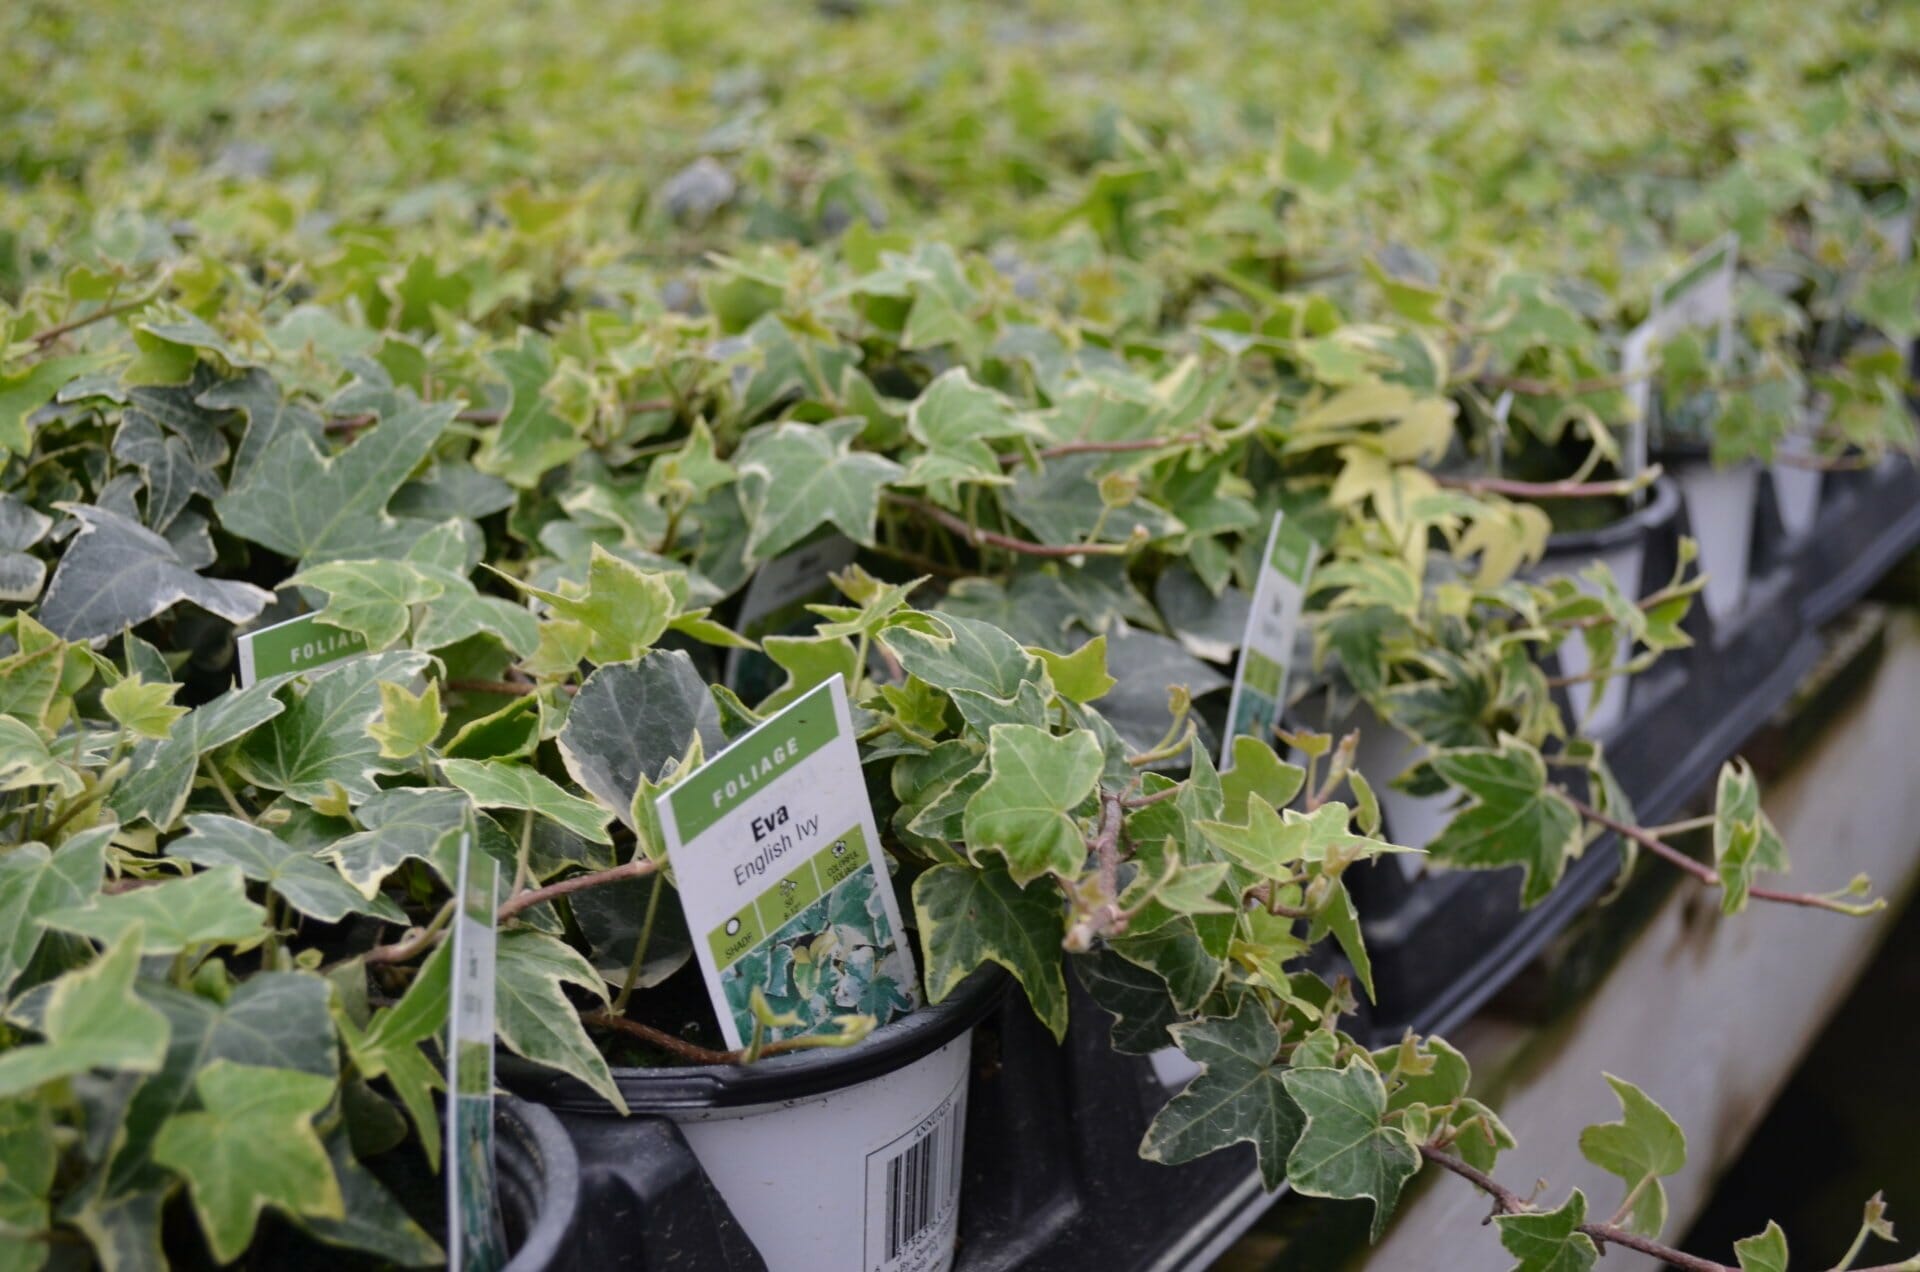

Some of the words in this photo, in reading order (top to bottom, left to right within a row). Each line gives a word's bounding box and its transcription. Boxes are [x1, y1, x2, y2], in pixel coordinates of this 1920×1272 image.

[290, 630, 362, 665] FOLIAG
[712, 736, 800, 809] FOLIAGE
[733, 834, 793, 887] English
[795, 814, 820, 842] Ivy
[750, 804, 790, 843] Eva
